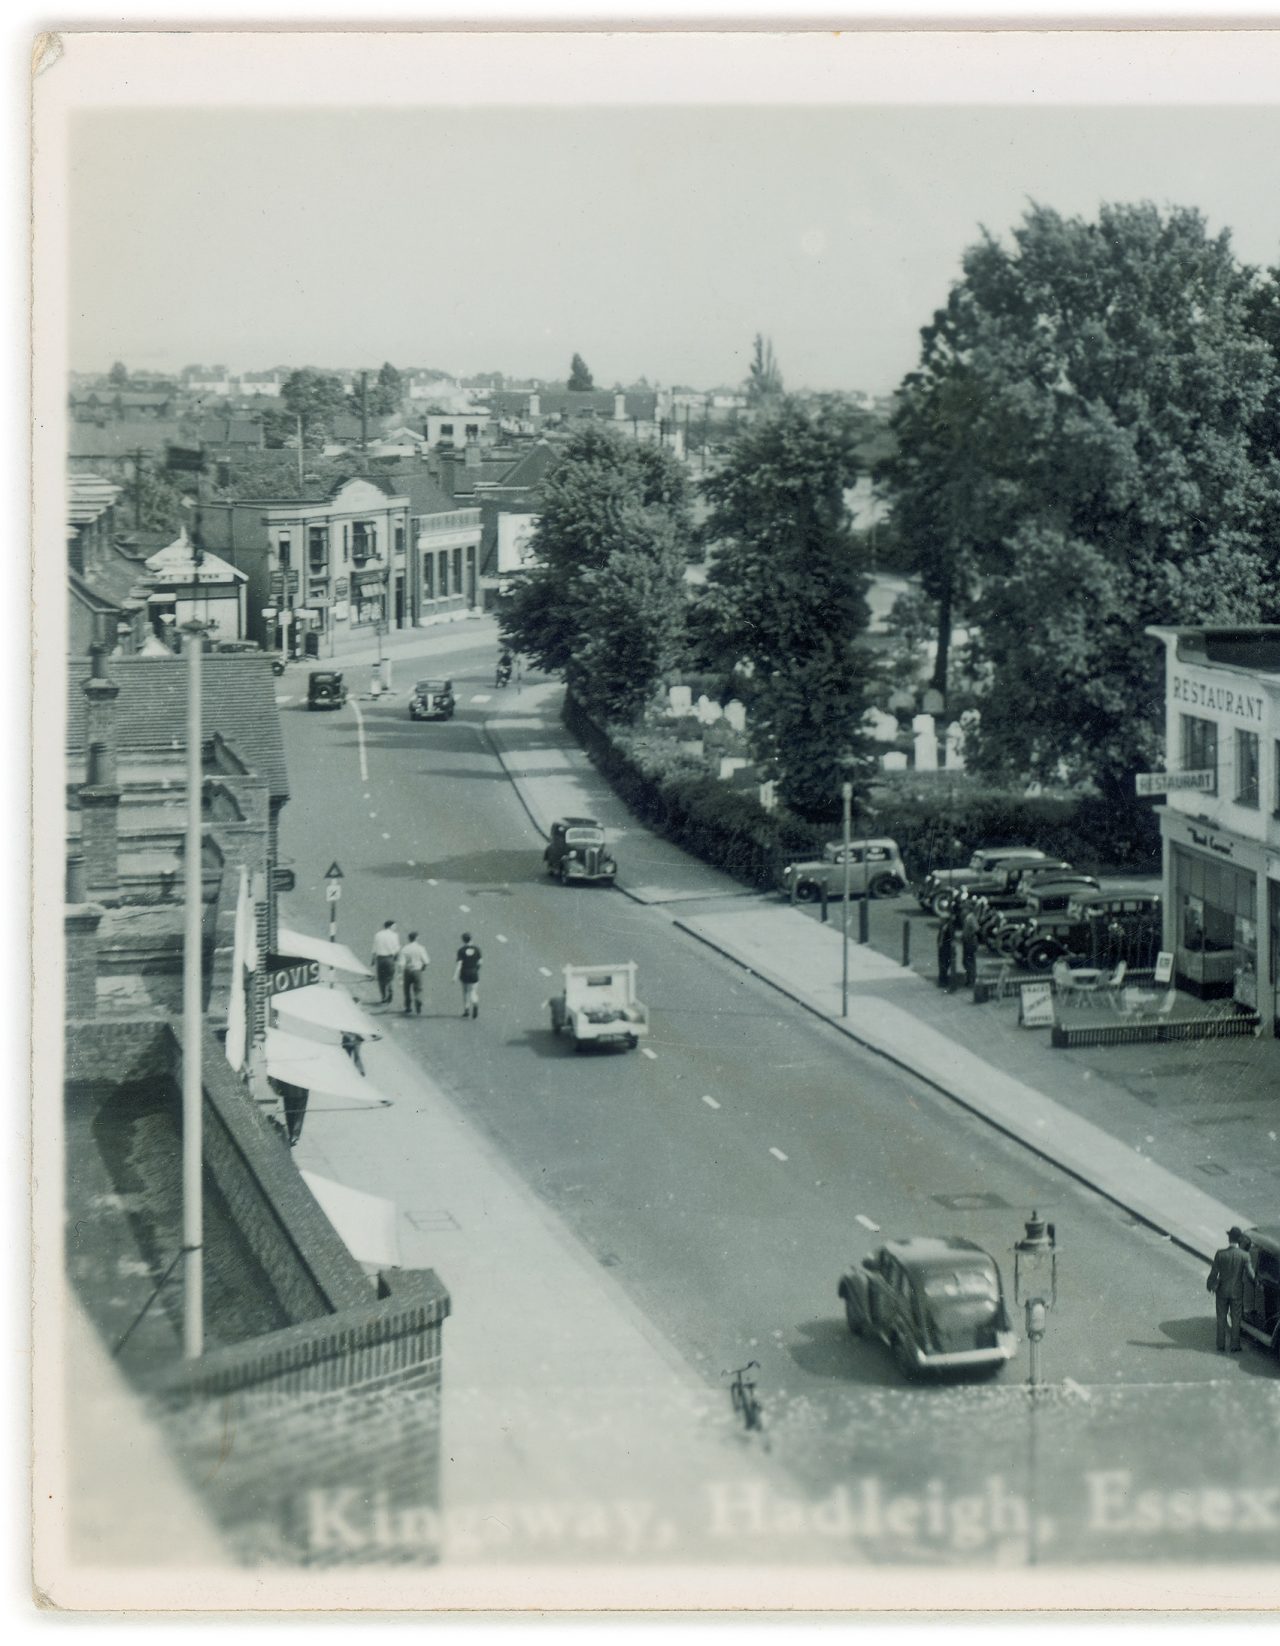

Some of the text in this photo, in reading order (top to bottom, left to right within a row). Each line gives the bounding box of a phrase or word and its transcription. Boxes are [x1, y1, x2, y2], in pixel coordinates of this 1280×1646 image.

[1174, 676, 1263, 720] RESTAURANT
[1139, 773, 1211, 791] RESTAURANT
[265, 962, 319, 994] HOVIS
